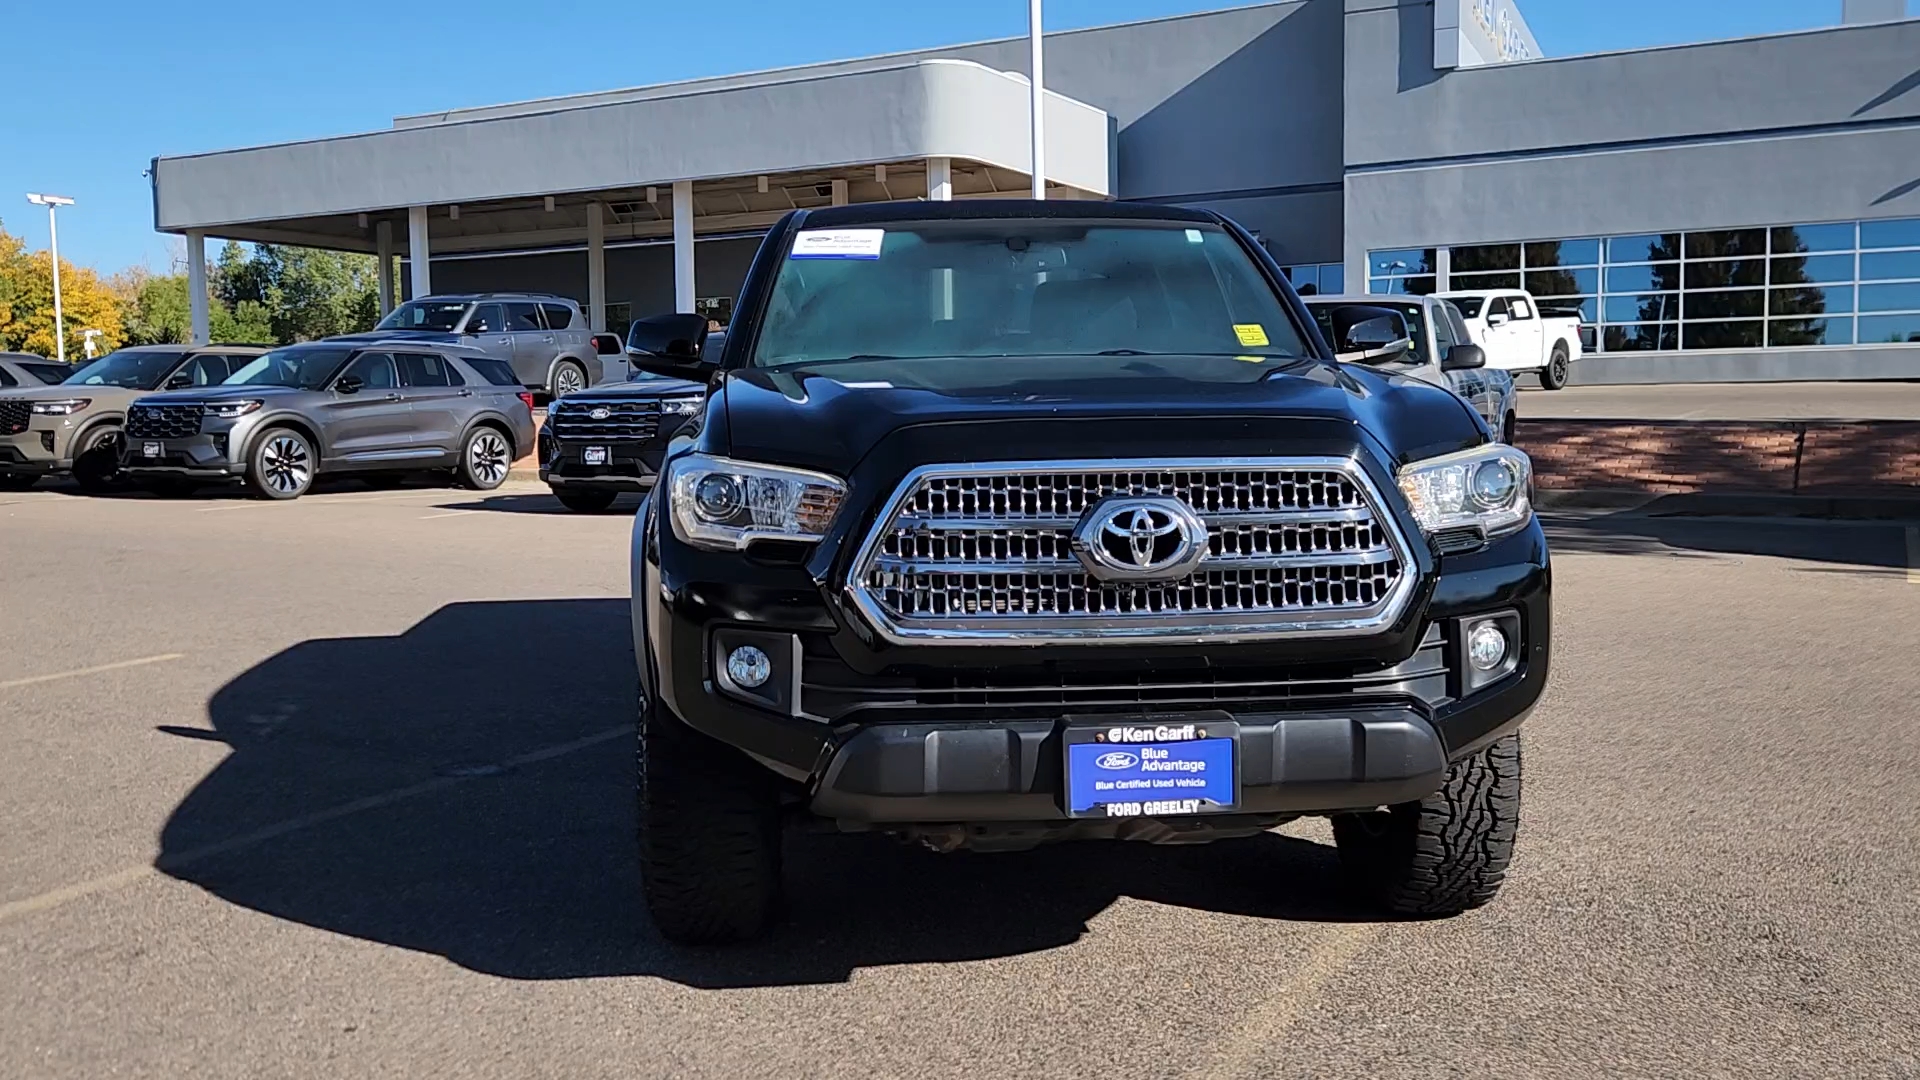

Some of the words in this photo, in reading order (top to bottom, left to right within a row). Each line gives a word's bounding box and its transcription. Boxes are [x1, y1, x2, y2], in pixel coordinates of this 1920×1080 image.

[1123, 727, 1154, 742] Ken
[1155, 724, 1196, 741] Garff
[1141, 747, 1168, 759] Blue
[1103, 754, 1131, 767] Ford
[1141, 759, 1206, 773] Advantage
[1095, 781, 1114, 790] Blue
[1115, 779, 1151, 790] Certified
[1152, 779, 1174, 788] Used
[1175, 778, 1206, 788] Vehicle
[1107, 801, 1141, 817] FORD
[1143, 799, 1200, 816] GREELEY
